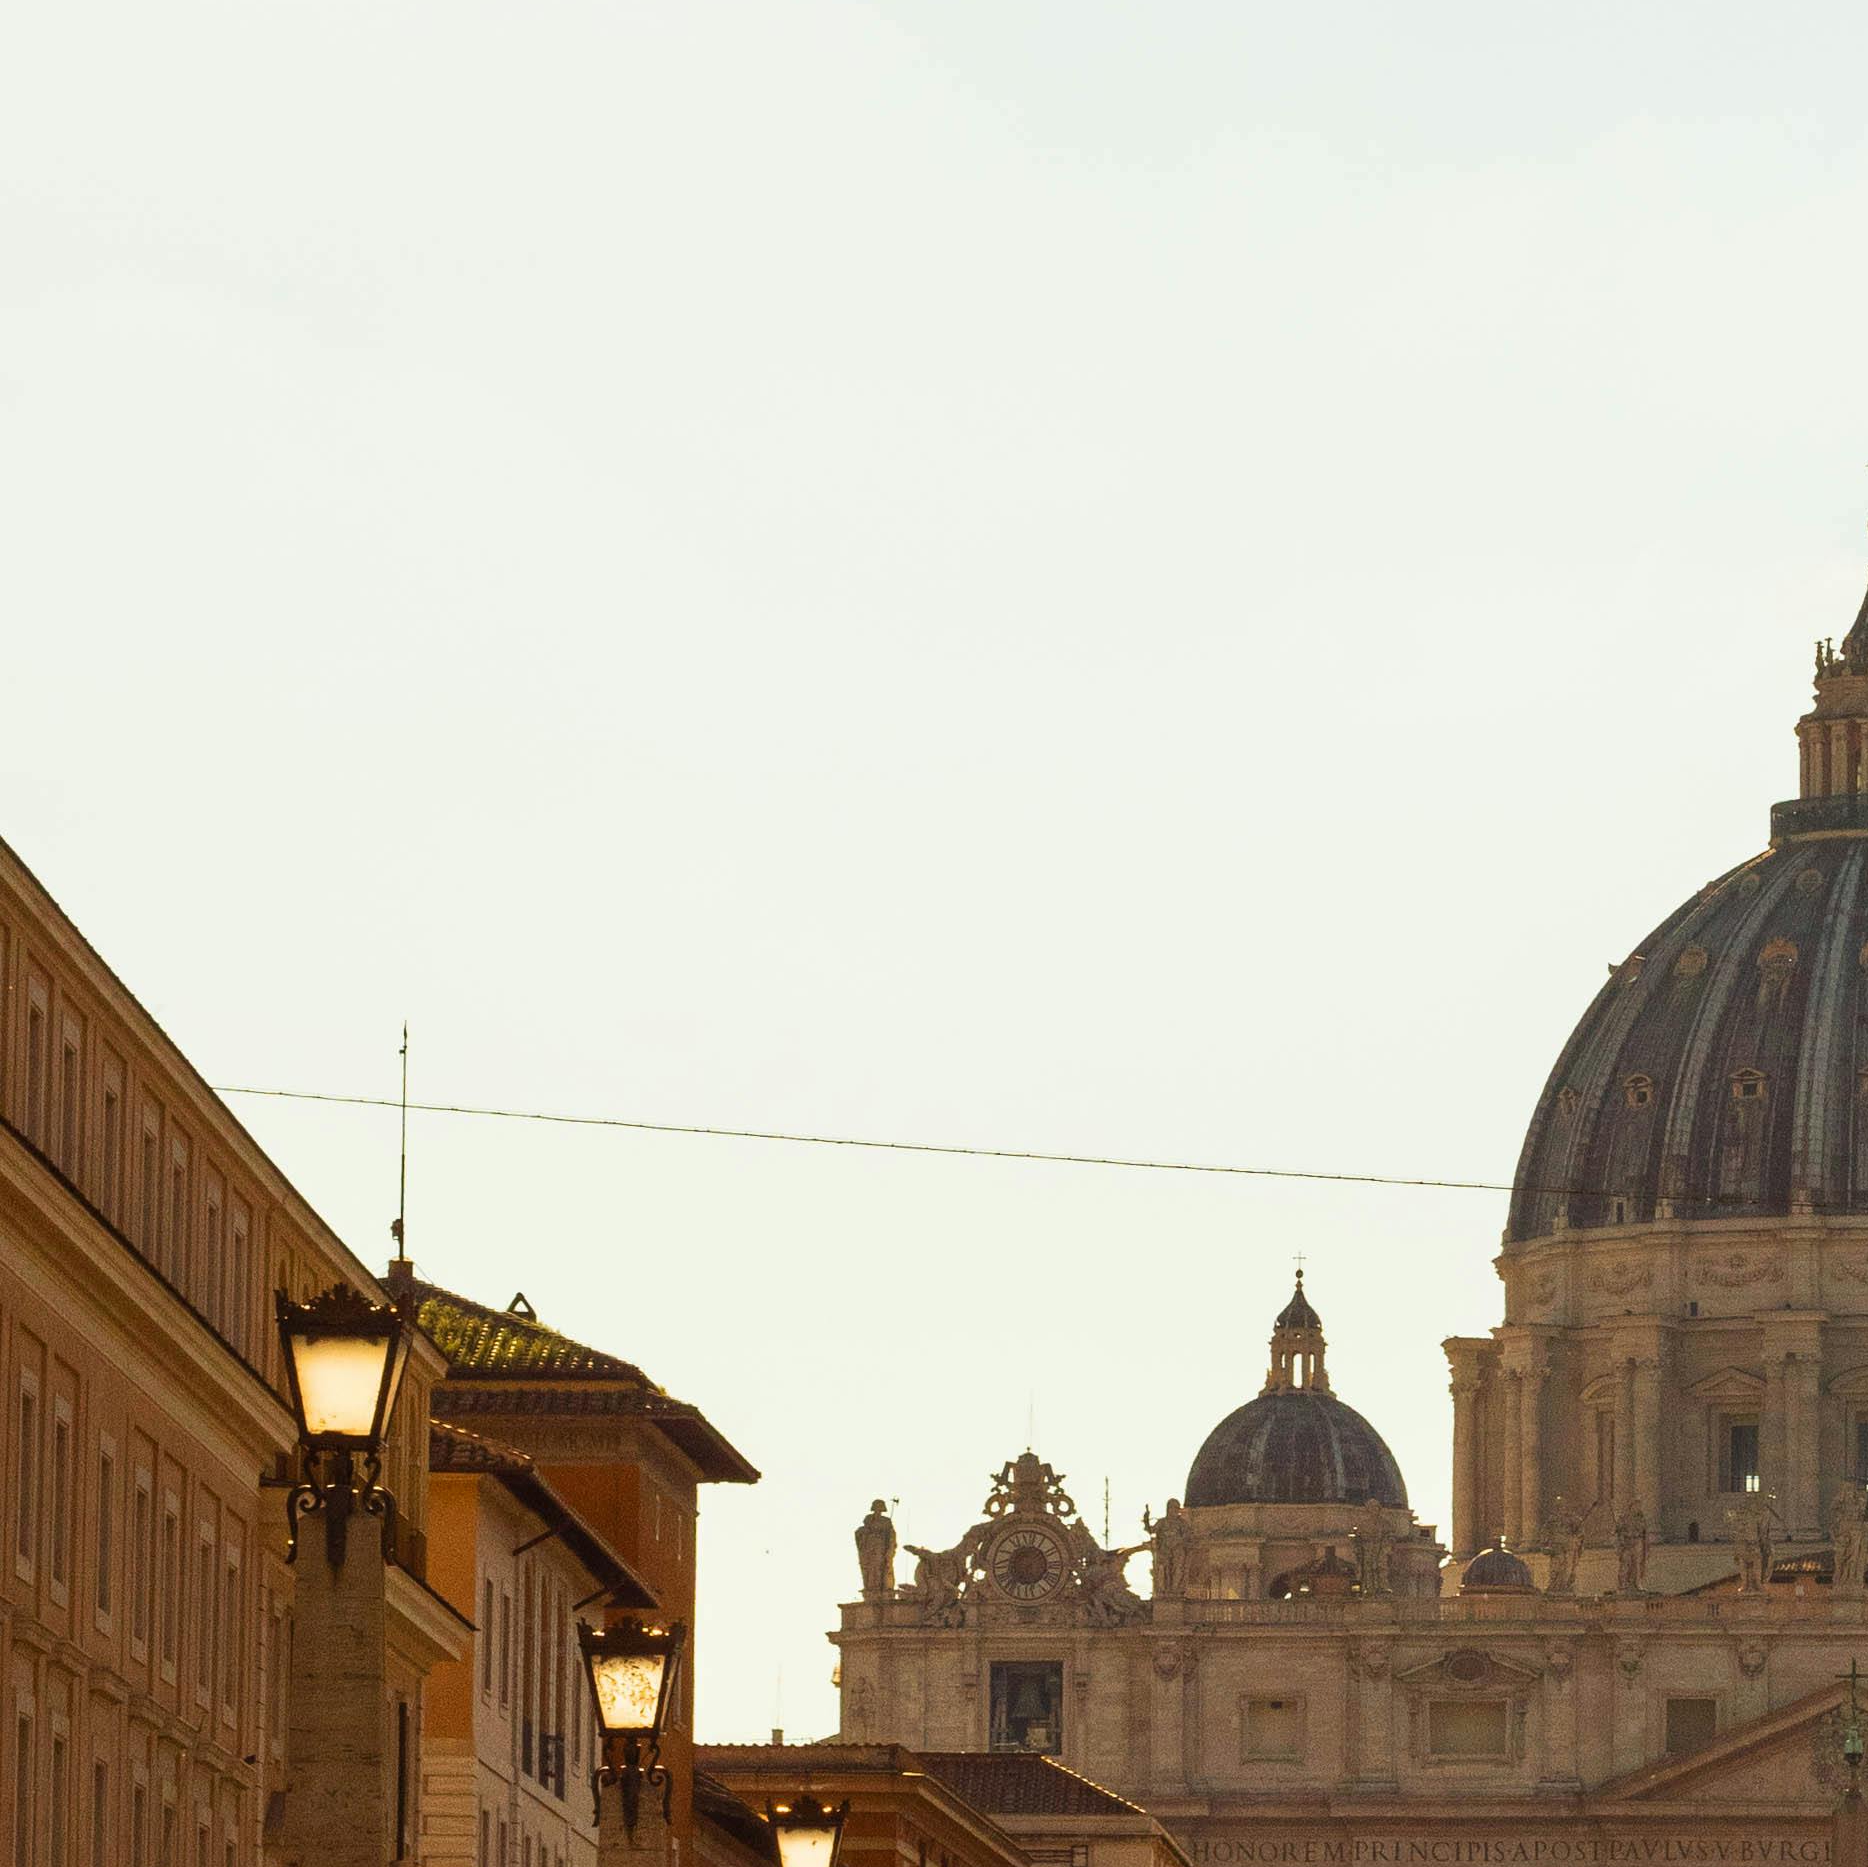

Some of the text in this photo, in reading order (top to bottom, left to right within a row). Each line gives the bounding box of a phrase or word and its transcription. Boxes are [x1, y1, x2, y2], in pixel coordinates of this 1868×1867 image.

[1192, 1841, 1348, 1863] HONOREM
[1354, 1840, 1505, 1862] PRINCIPIS
[1511, 1841, 1600, 1862] APOST
[1609, 1840, 1707, 1861] PAVLVS
